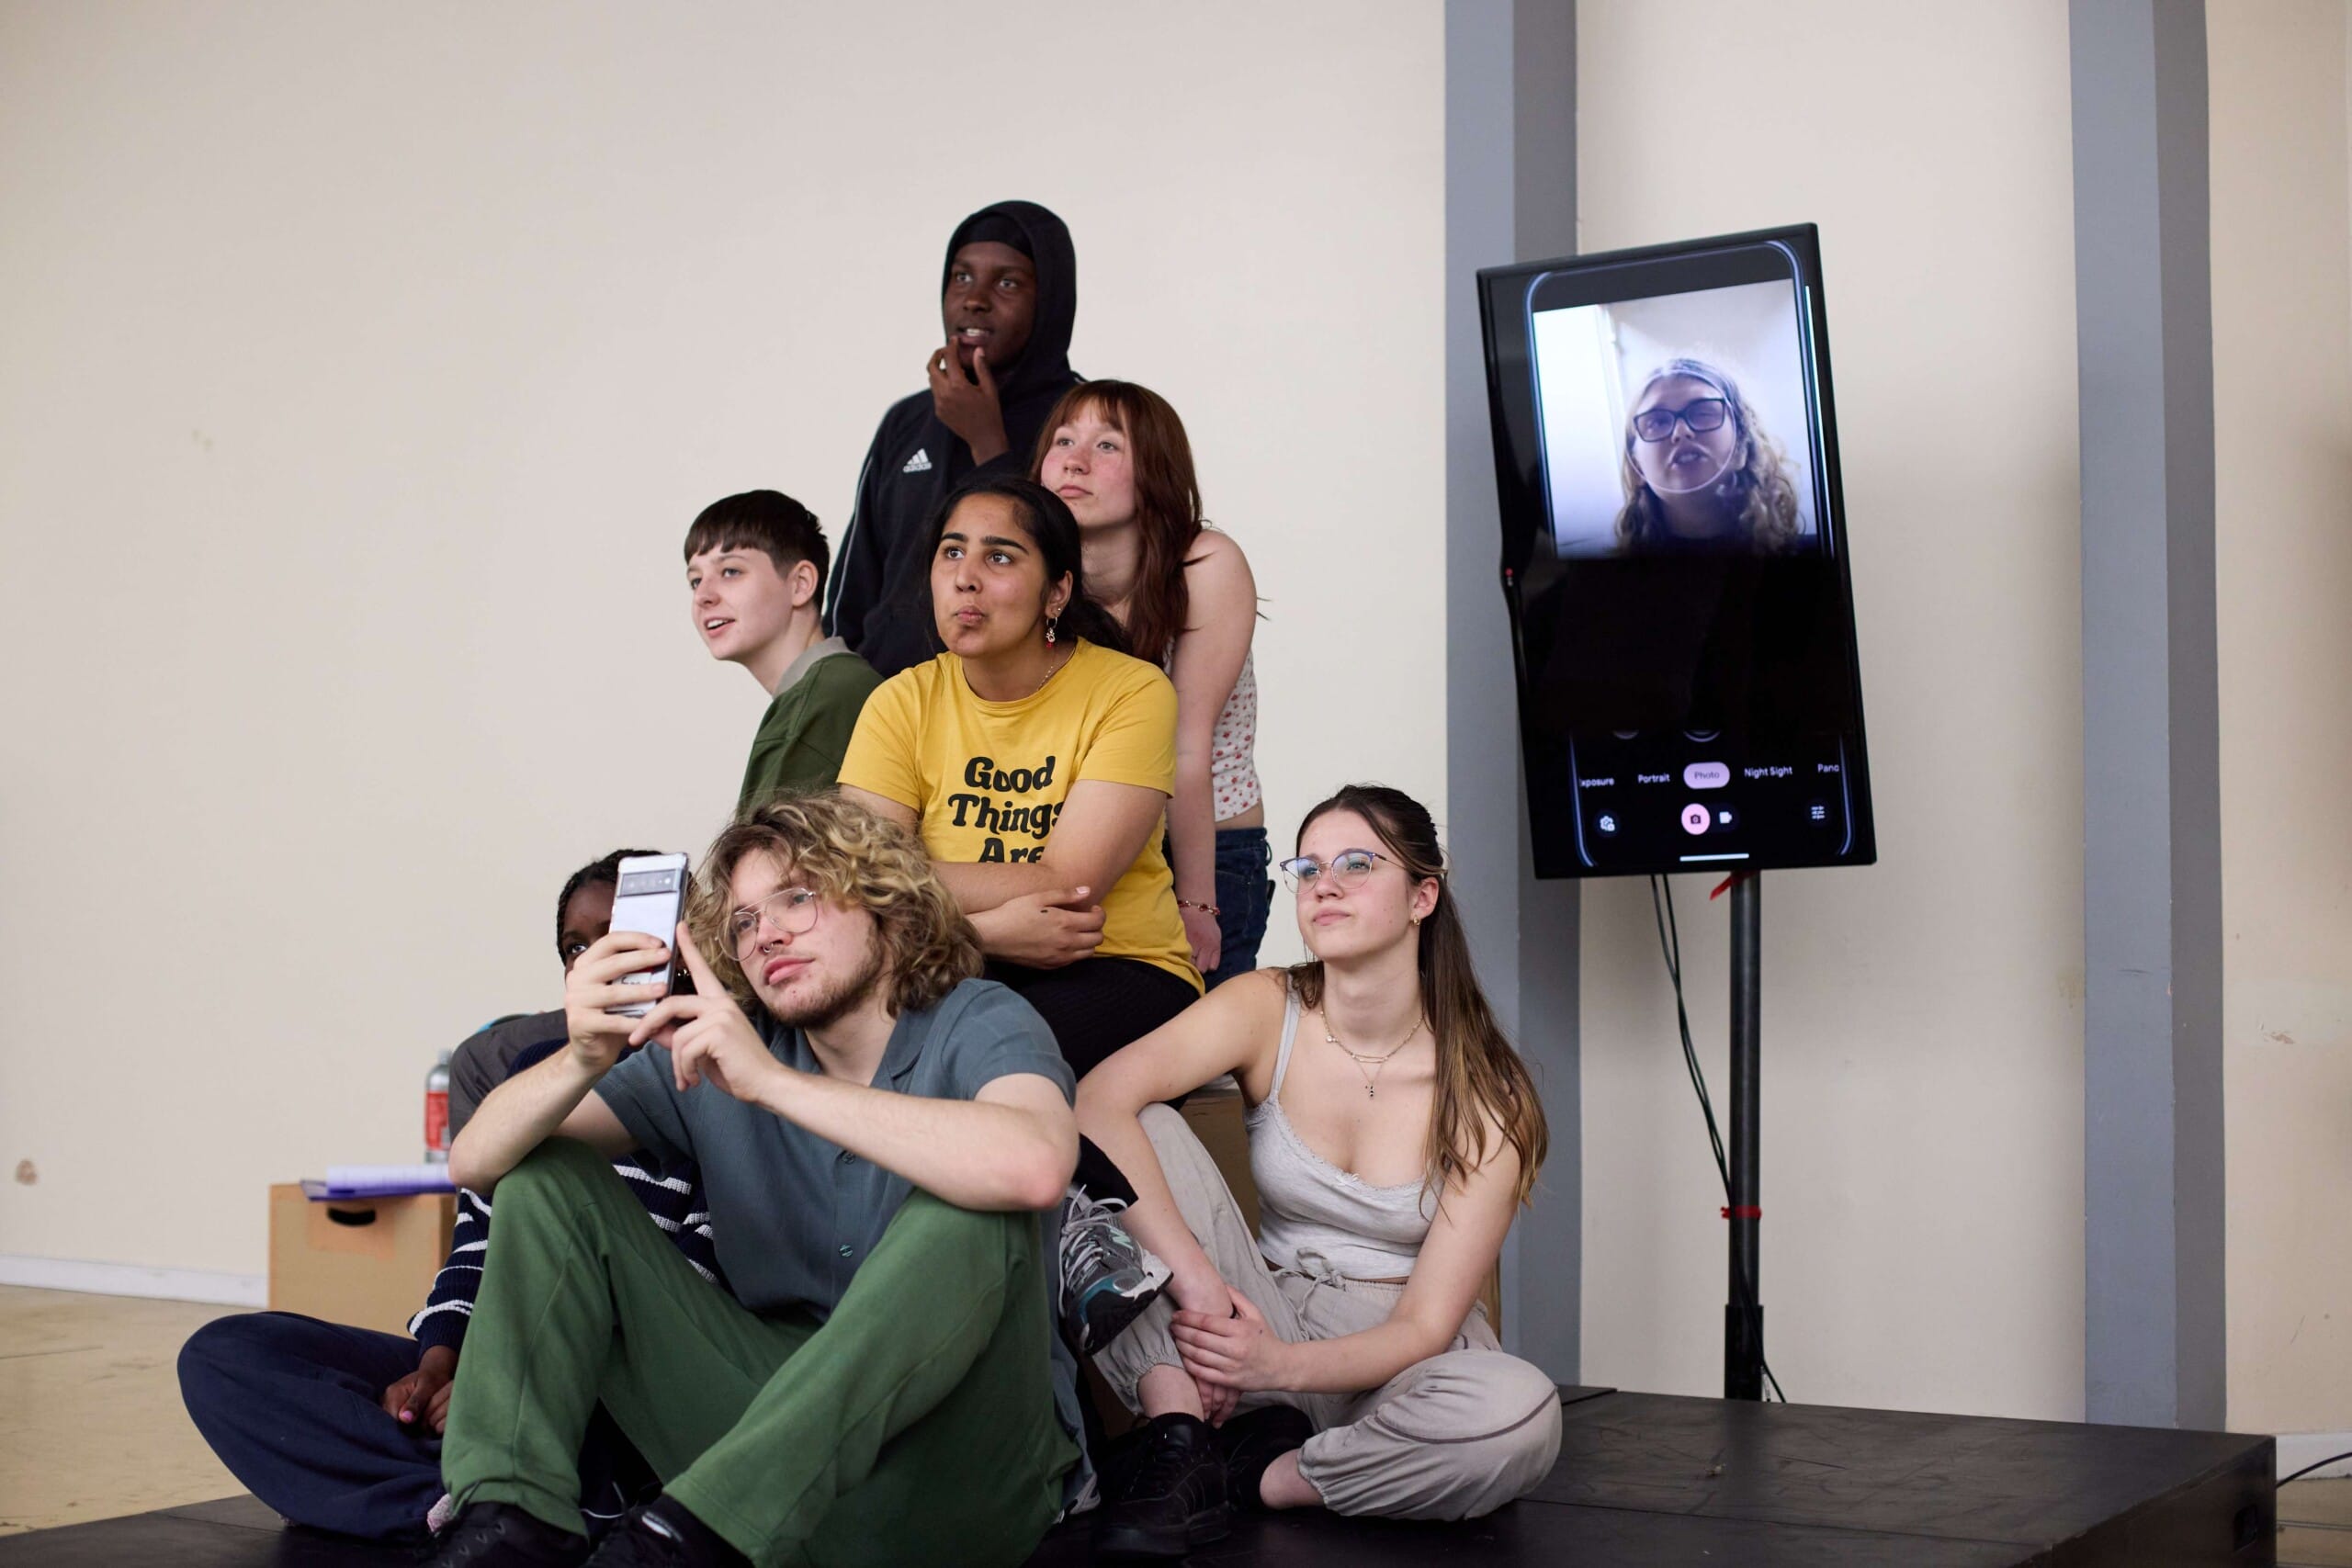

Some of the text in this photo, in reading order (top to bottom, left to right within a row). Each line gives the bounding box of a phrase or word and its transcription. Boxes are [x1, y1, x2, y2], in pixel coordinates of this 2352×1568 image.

[964, 755, 1056, 793] Good
[1579, 777, 1615, 788] xposure
[1637, 773, 1670, 784] Portrait
[1693, 771, 1720, 780] Photo
[1744, 767, 1769, 779] Night
[1770, 766, 1793, 778] Sight
